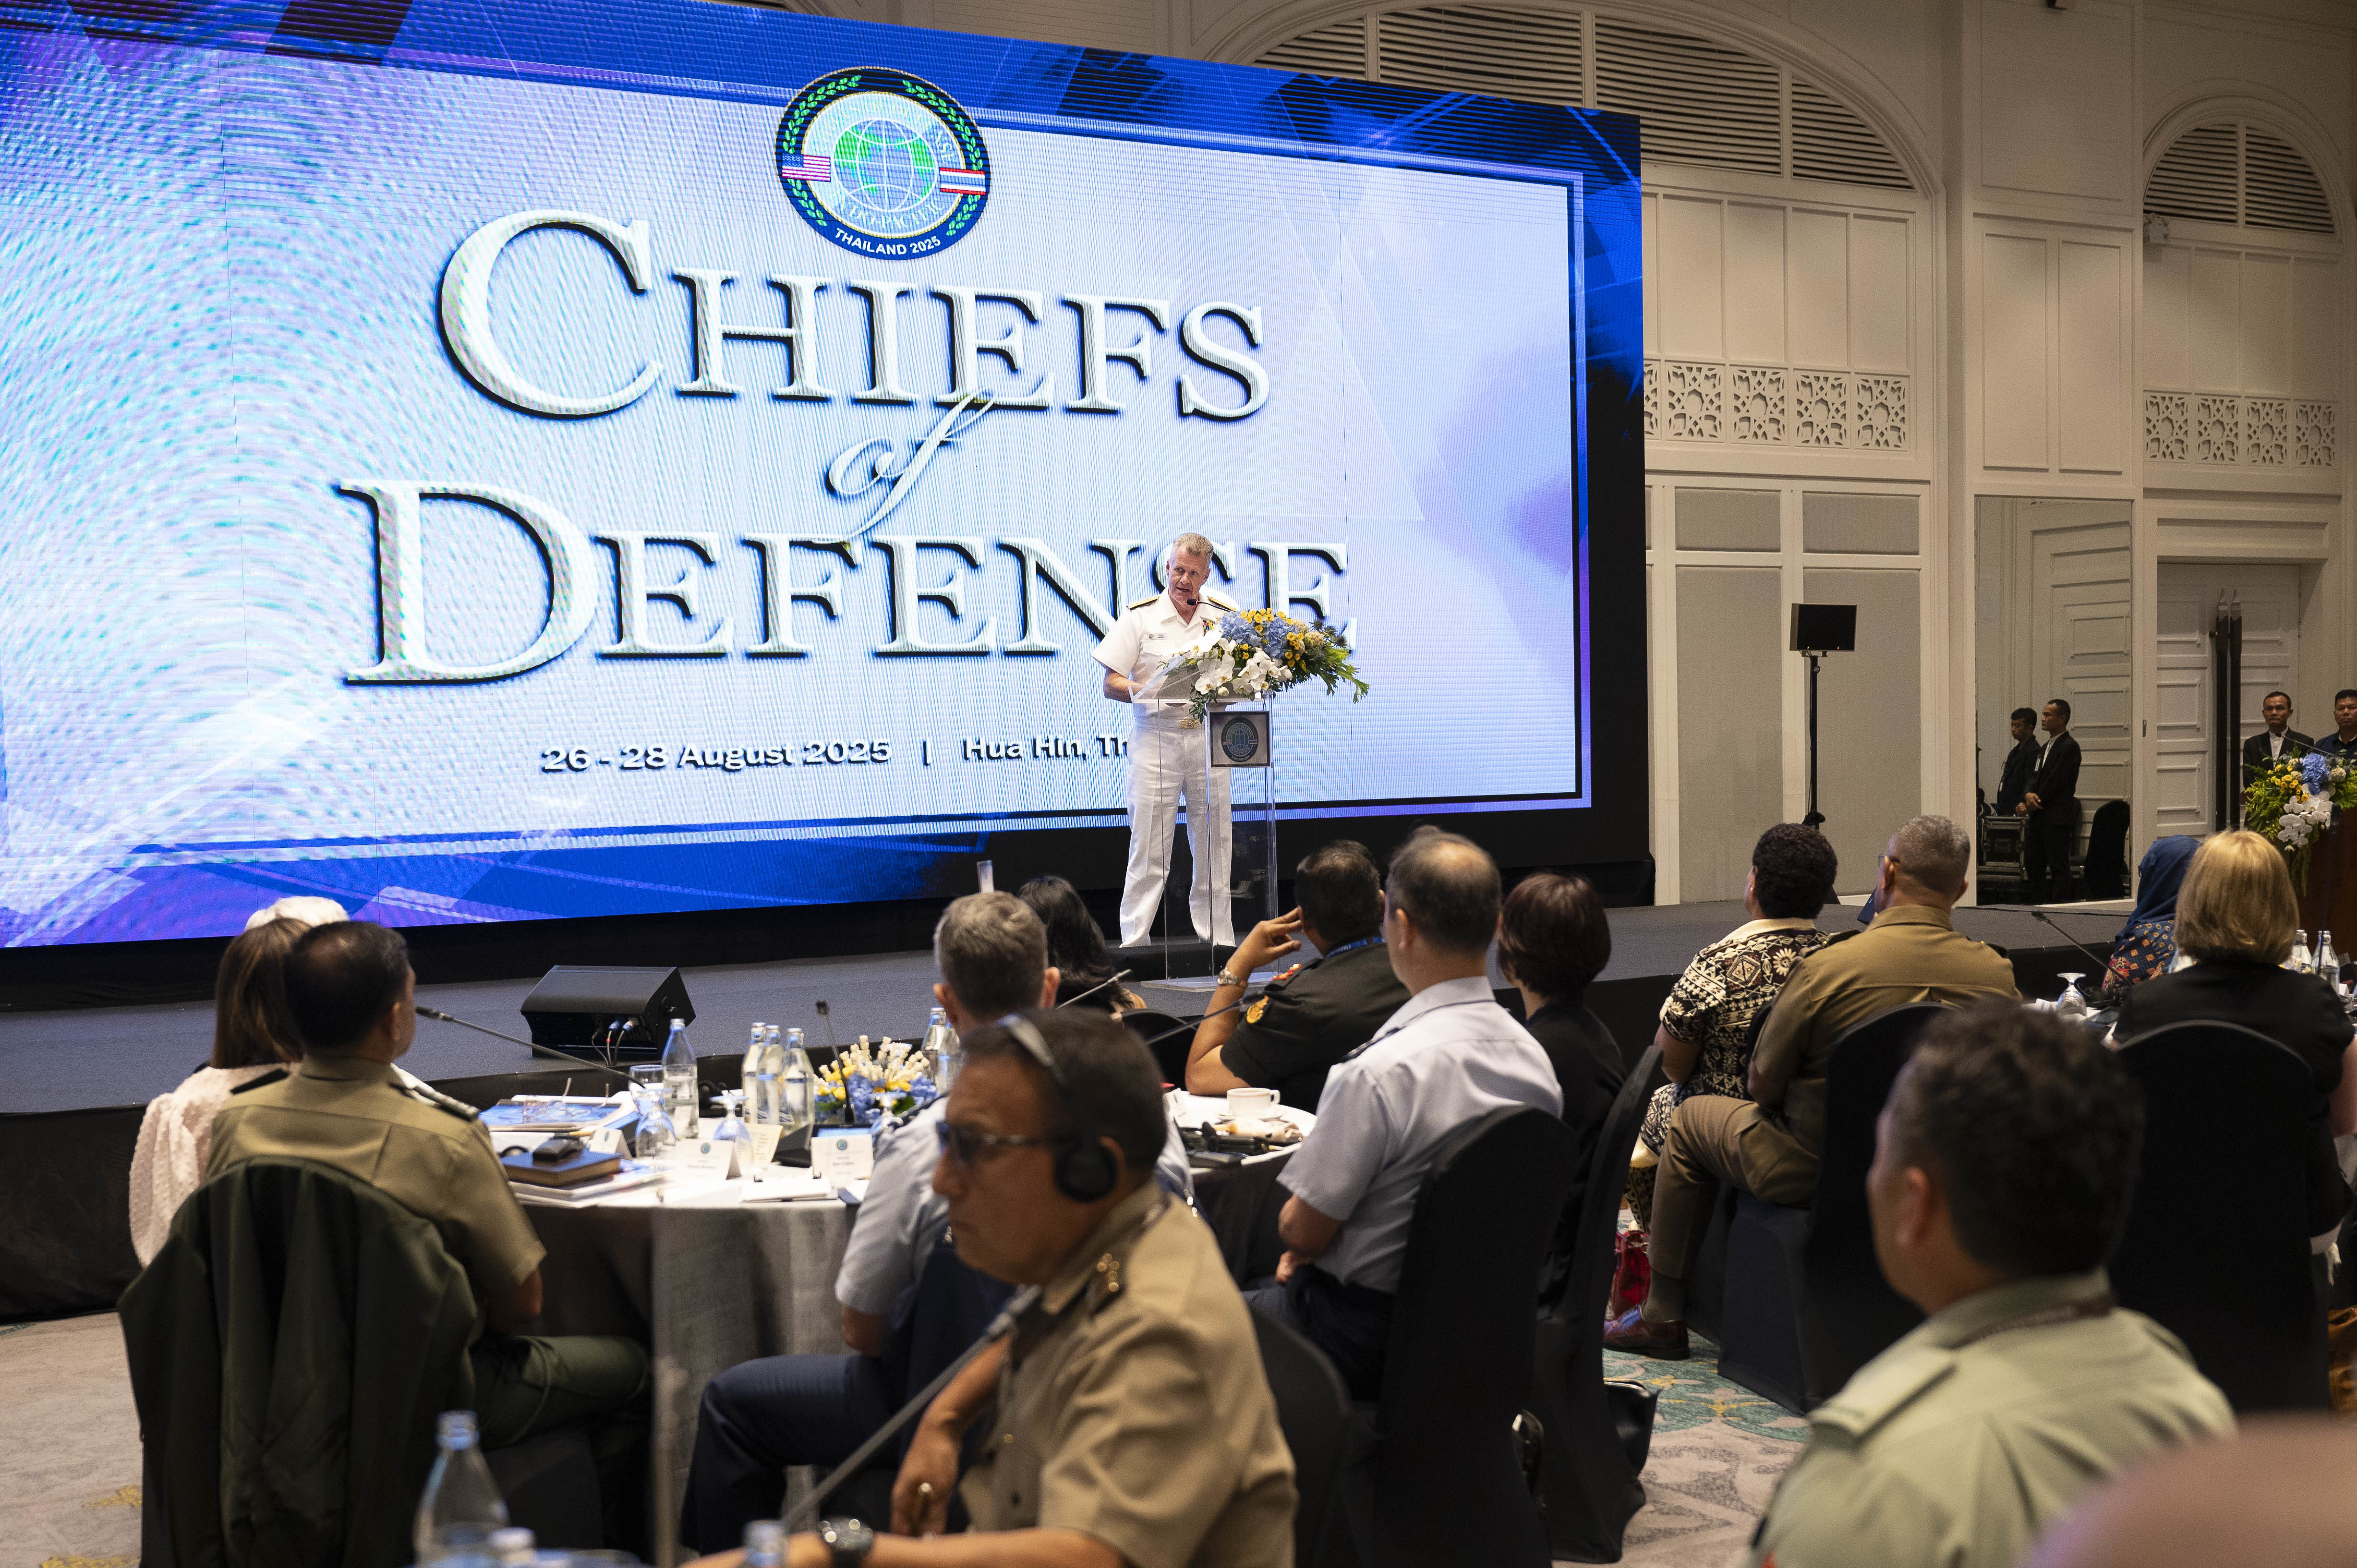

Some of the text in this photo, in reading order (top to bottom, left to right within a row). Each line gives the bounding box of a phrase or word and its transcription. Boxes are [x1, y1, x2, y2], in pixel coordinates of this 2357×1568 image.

[835, 228, 941, 255] THAILAND 2025
[437, 209, 1270, 422] CHIEFS
[811, 387, 997, 544] of
[542, 744, 592, 772] 26
[621, 744, 669, 770] 28
[677, 742, 793, 772] August
[803, 738, 892, 764] 2025
[963, 737, 1026, 760] Hua
[1033, 736, 1087, 760] Hin,
